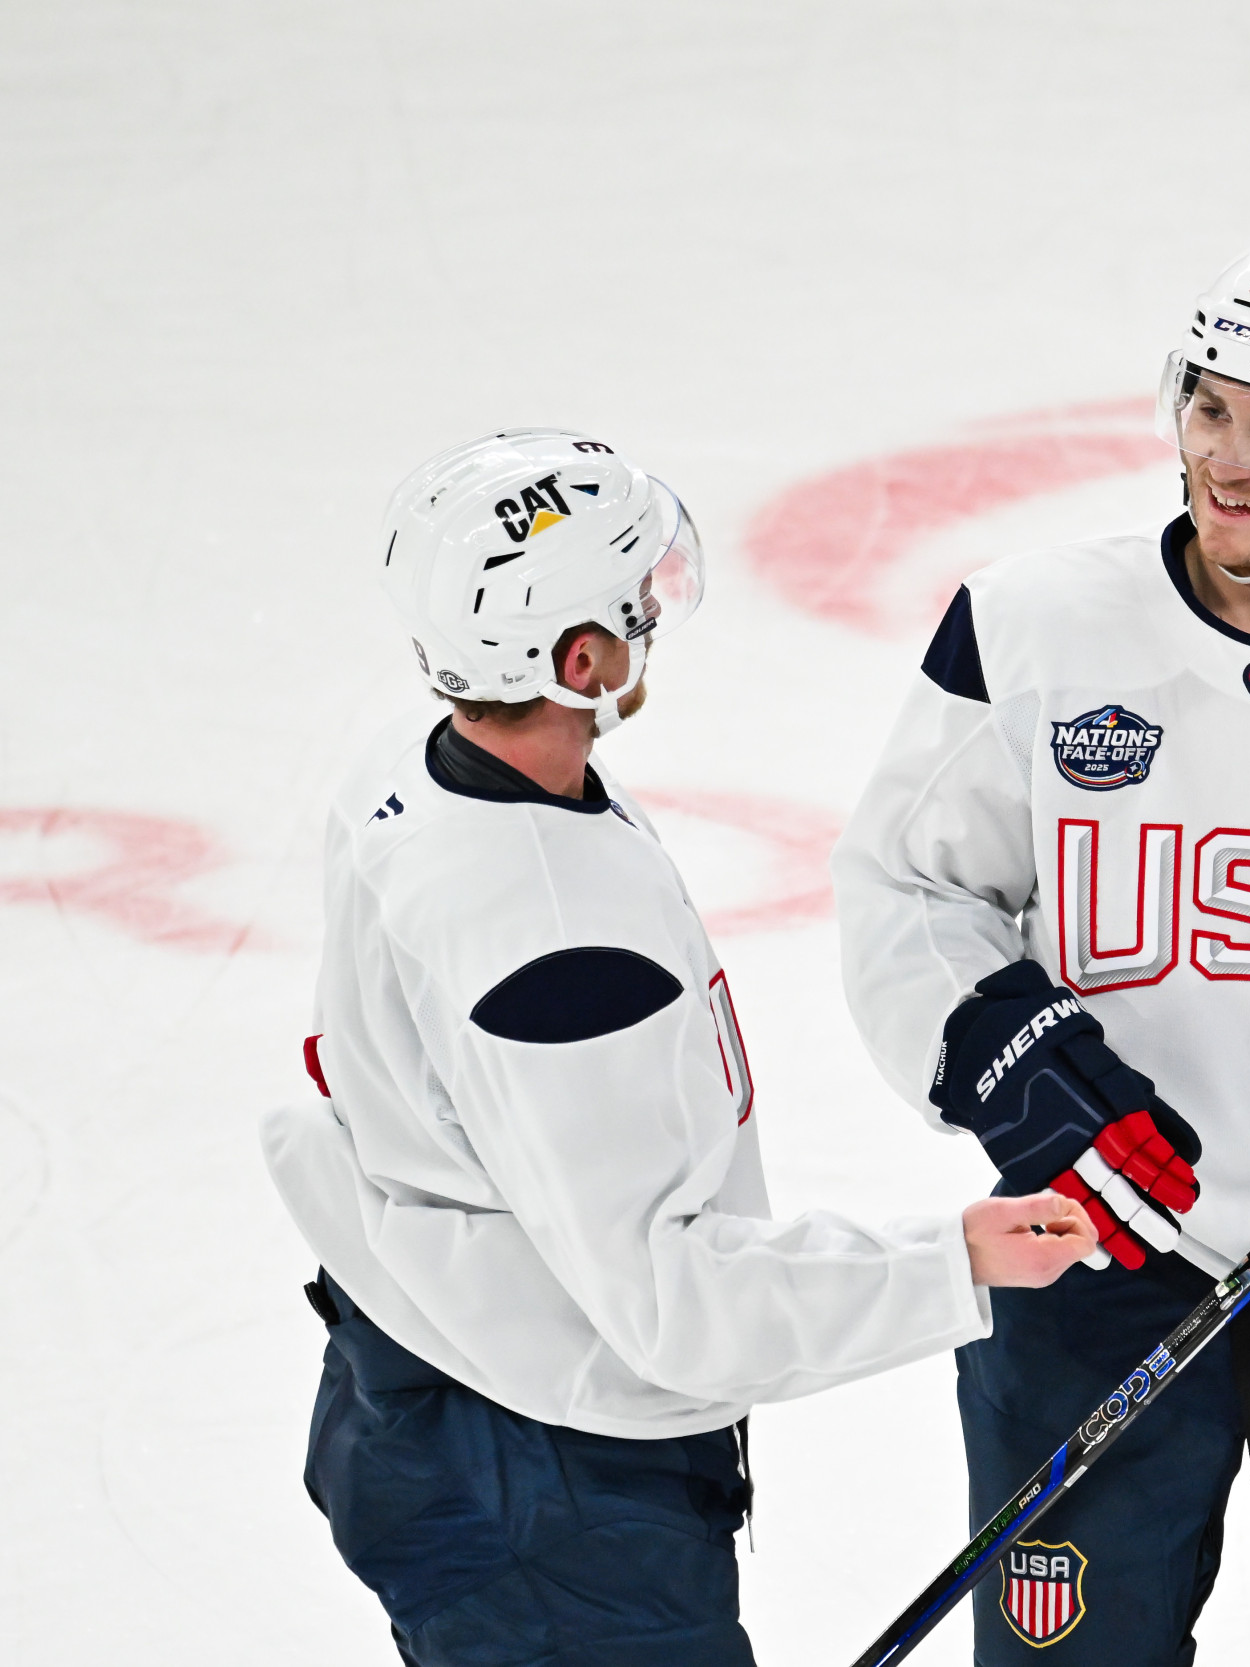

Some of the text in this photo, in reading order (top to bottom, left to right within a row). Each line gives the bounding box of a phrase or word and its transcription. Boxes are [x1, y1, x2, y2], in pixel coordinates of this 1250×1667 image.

[494, 473, 572, 542] CAT
[1056, 726, 1159, 747] NATIONS
[1062, 746, 1147, 761] FACE-OFF
[935, 1041, 948, 1086] TKACHUK
[976, 998, 1088, 1103] SHERW
[1079, 1343, 1176, 1445] CODE
[1016, 1481, 1043, 1510] PRO
[1010, 1552, 1070, 1578] USA
